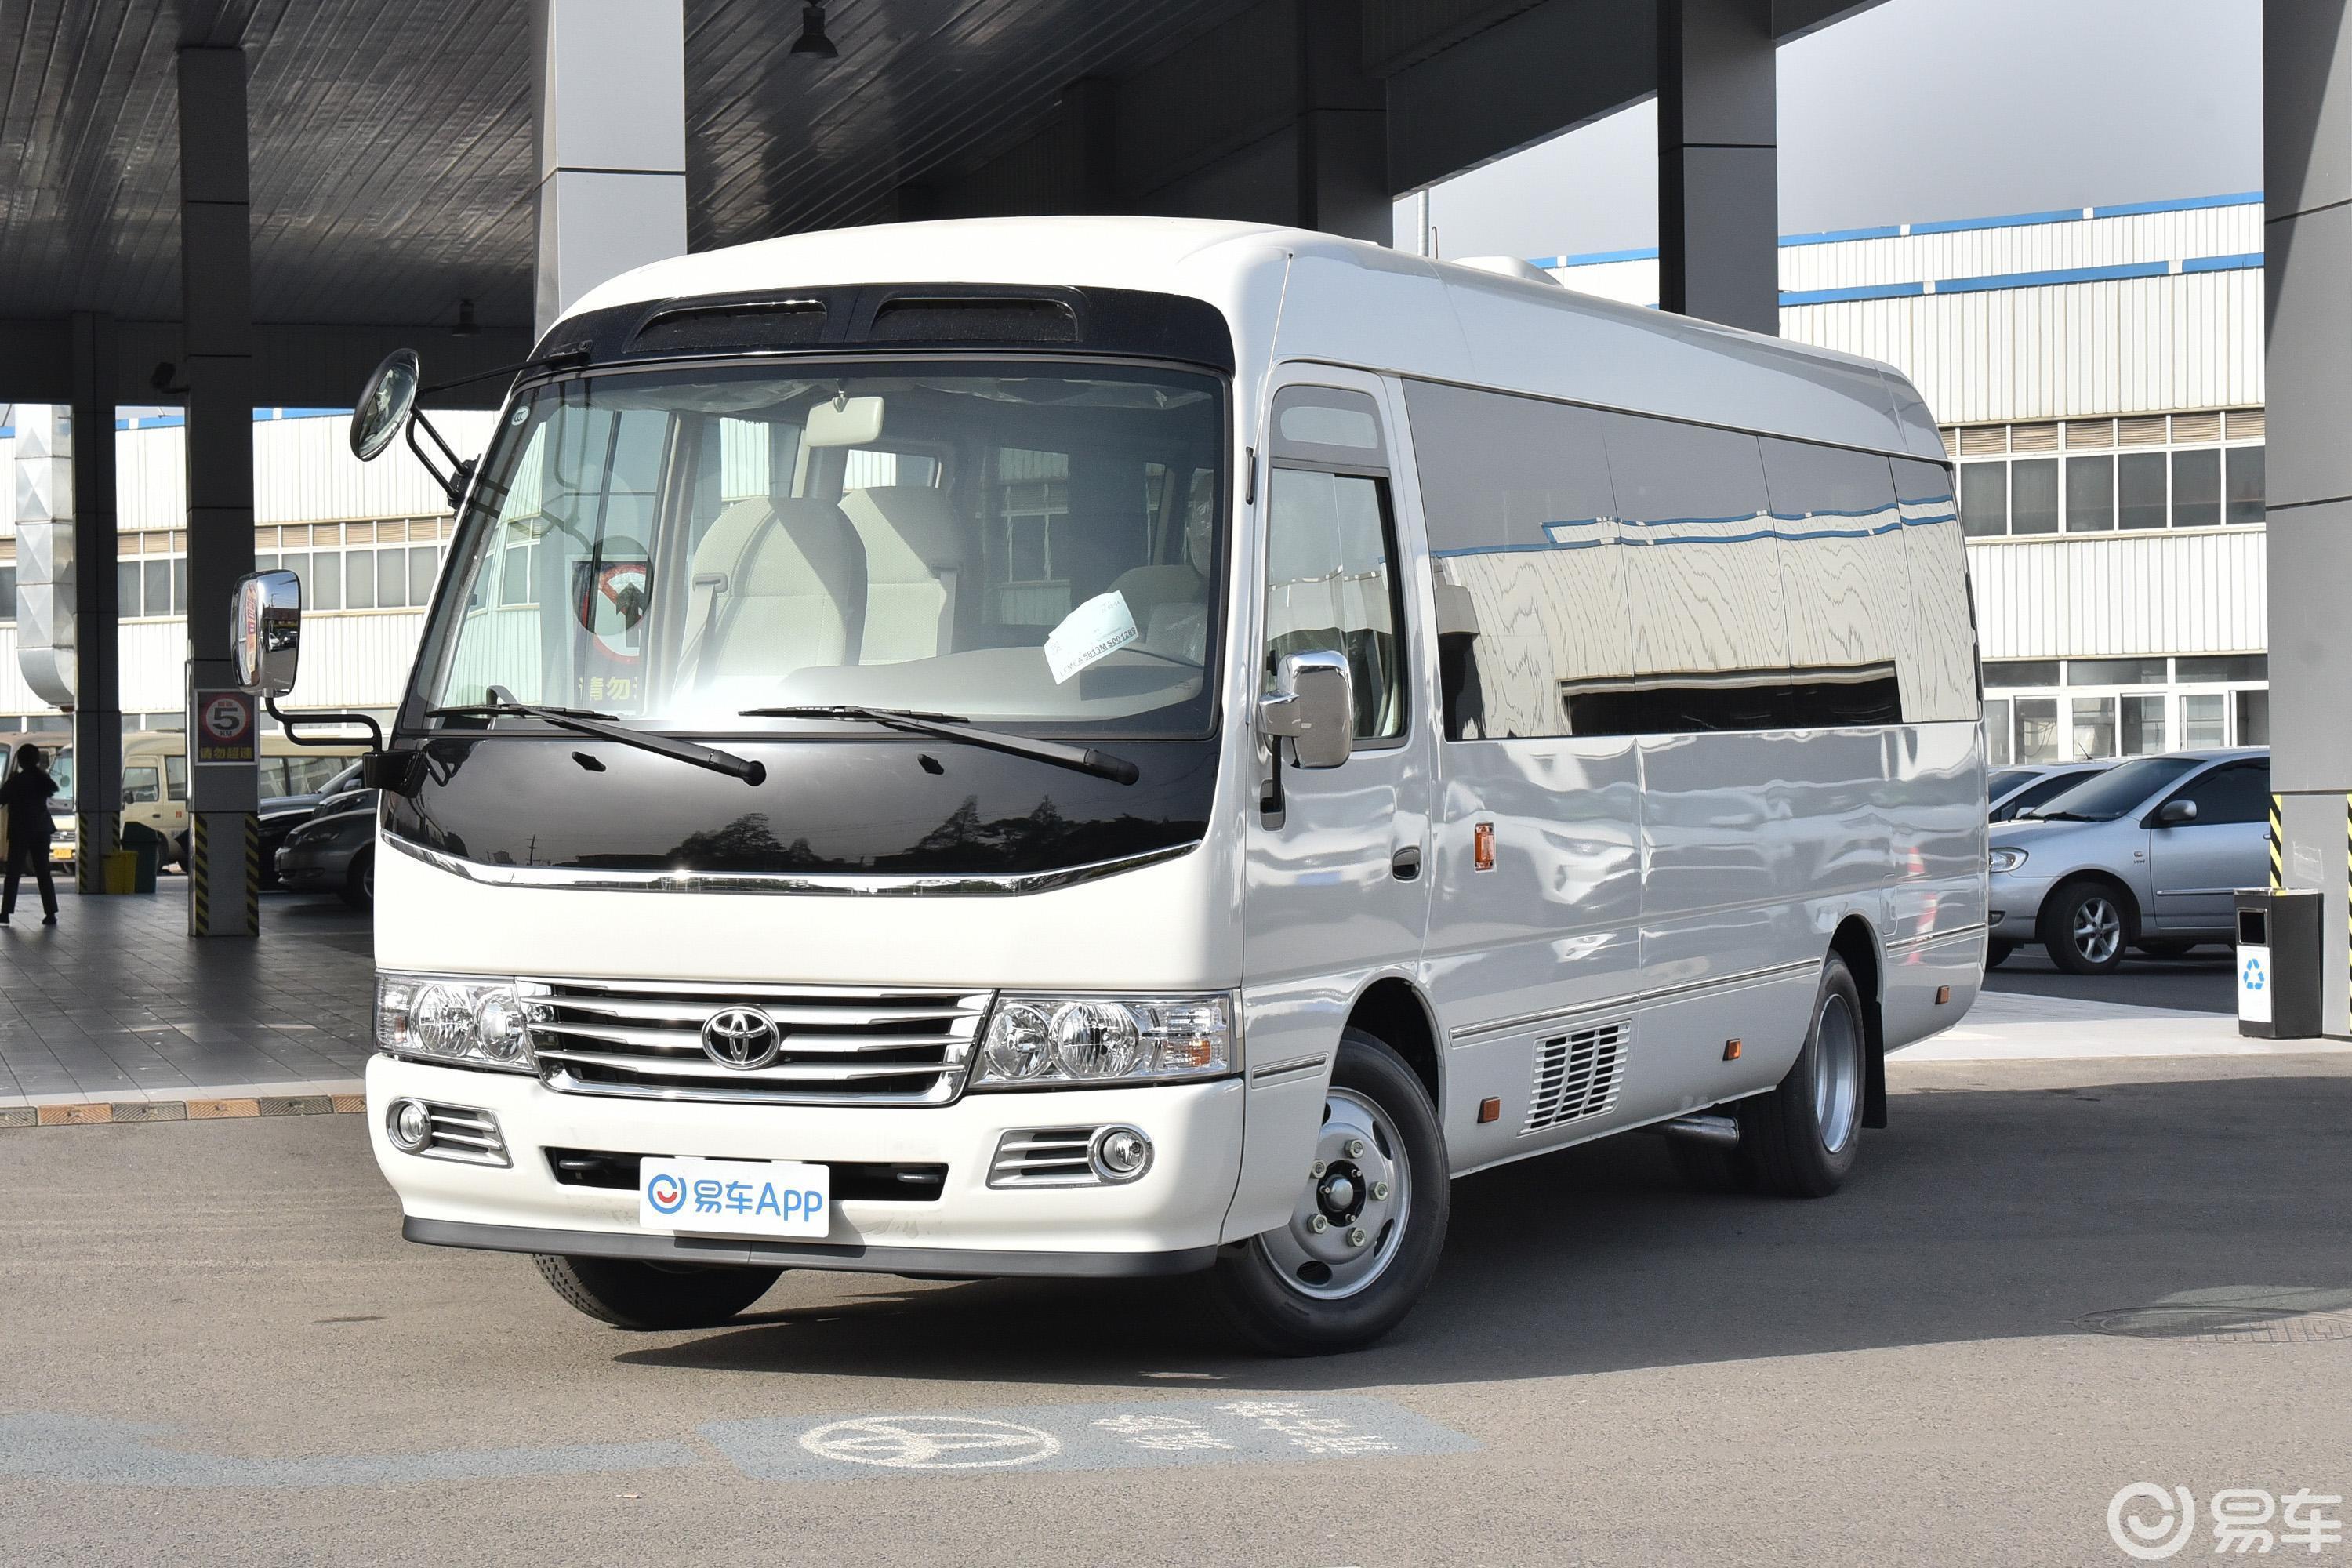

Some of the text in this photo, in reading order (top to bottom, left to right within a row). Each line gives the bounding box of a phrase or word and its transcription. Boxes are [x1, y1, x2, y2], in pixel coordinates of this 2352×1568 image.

[578, 676, 639, 701] 请勿
[212, 707, 240, 731] 5
[693, 1178, 823, 1222] 易车App
